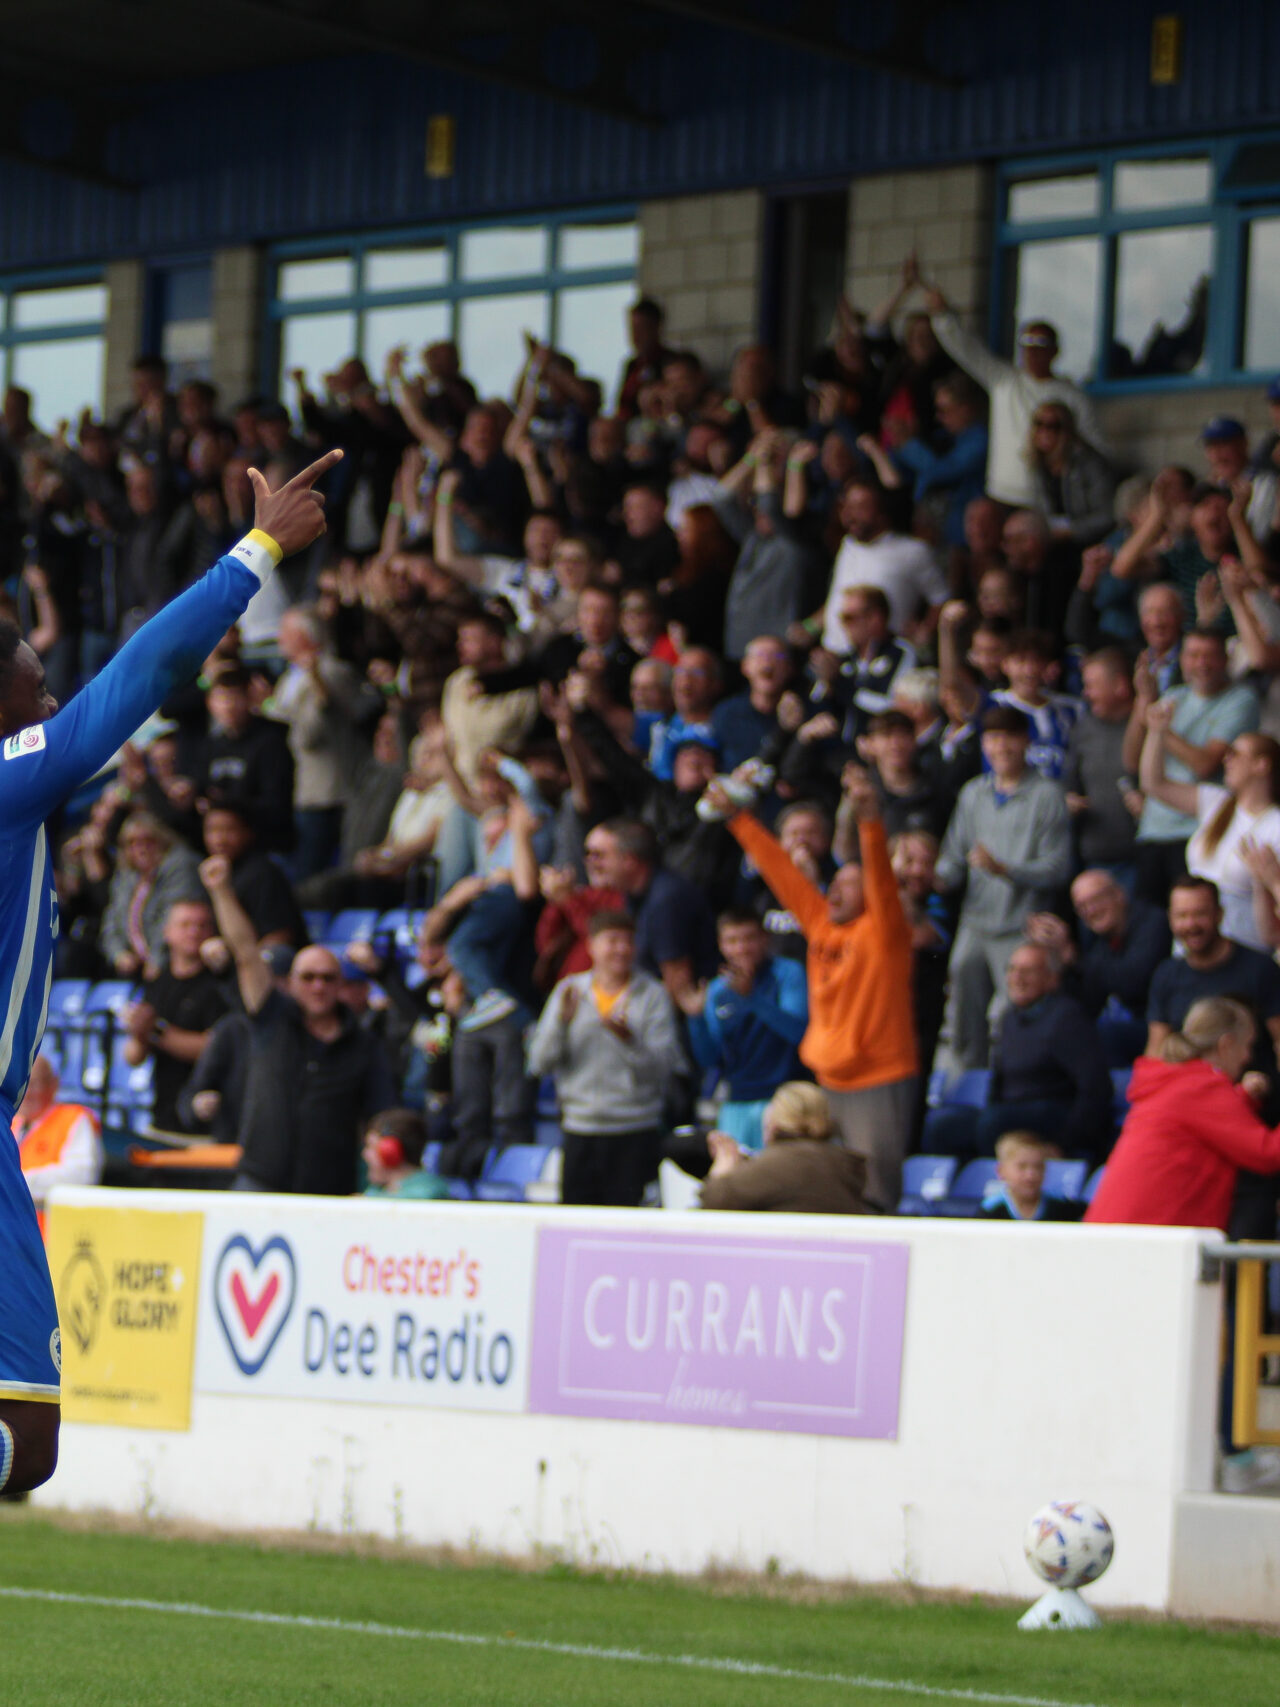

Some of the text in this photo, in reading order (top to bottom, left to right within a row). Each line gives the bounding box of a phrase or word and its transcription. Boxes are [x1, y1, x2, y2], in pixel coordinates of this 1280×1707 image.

[114, 1261, 171, 1293] HOPE
[342, 1243, 479, 1299] Chester's
[111, 1298, 179, 1331] GLORY
[584, 1275, 847, 1364] CURRANS
[304, 1308, 513, 1385] Dee Radio
[666, 1354, 747, 1417] homes
